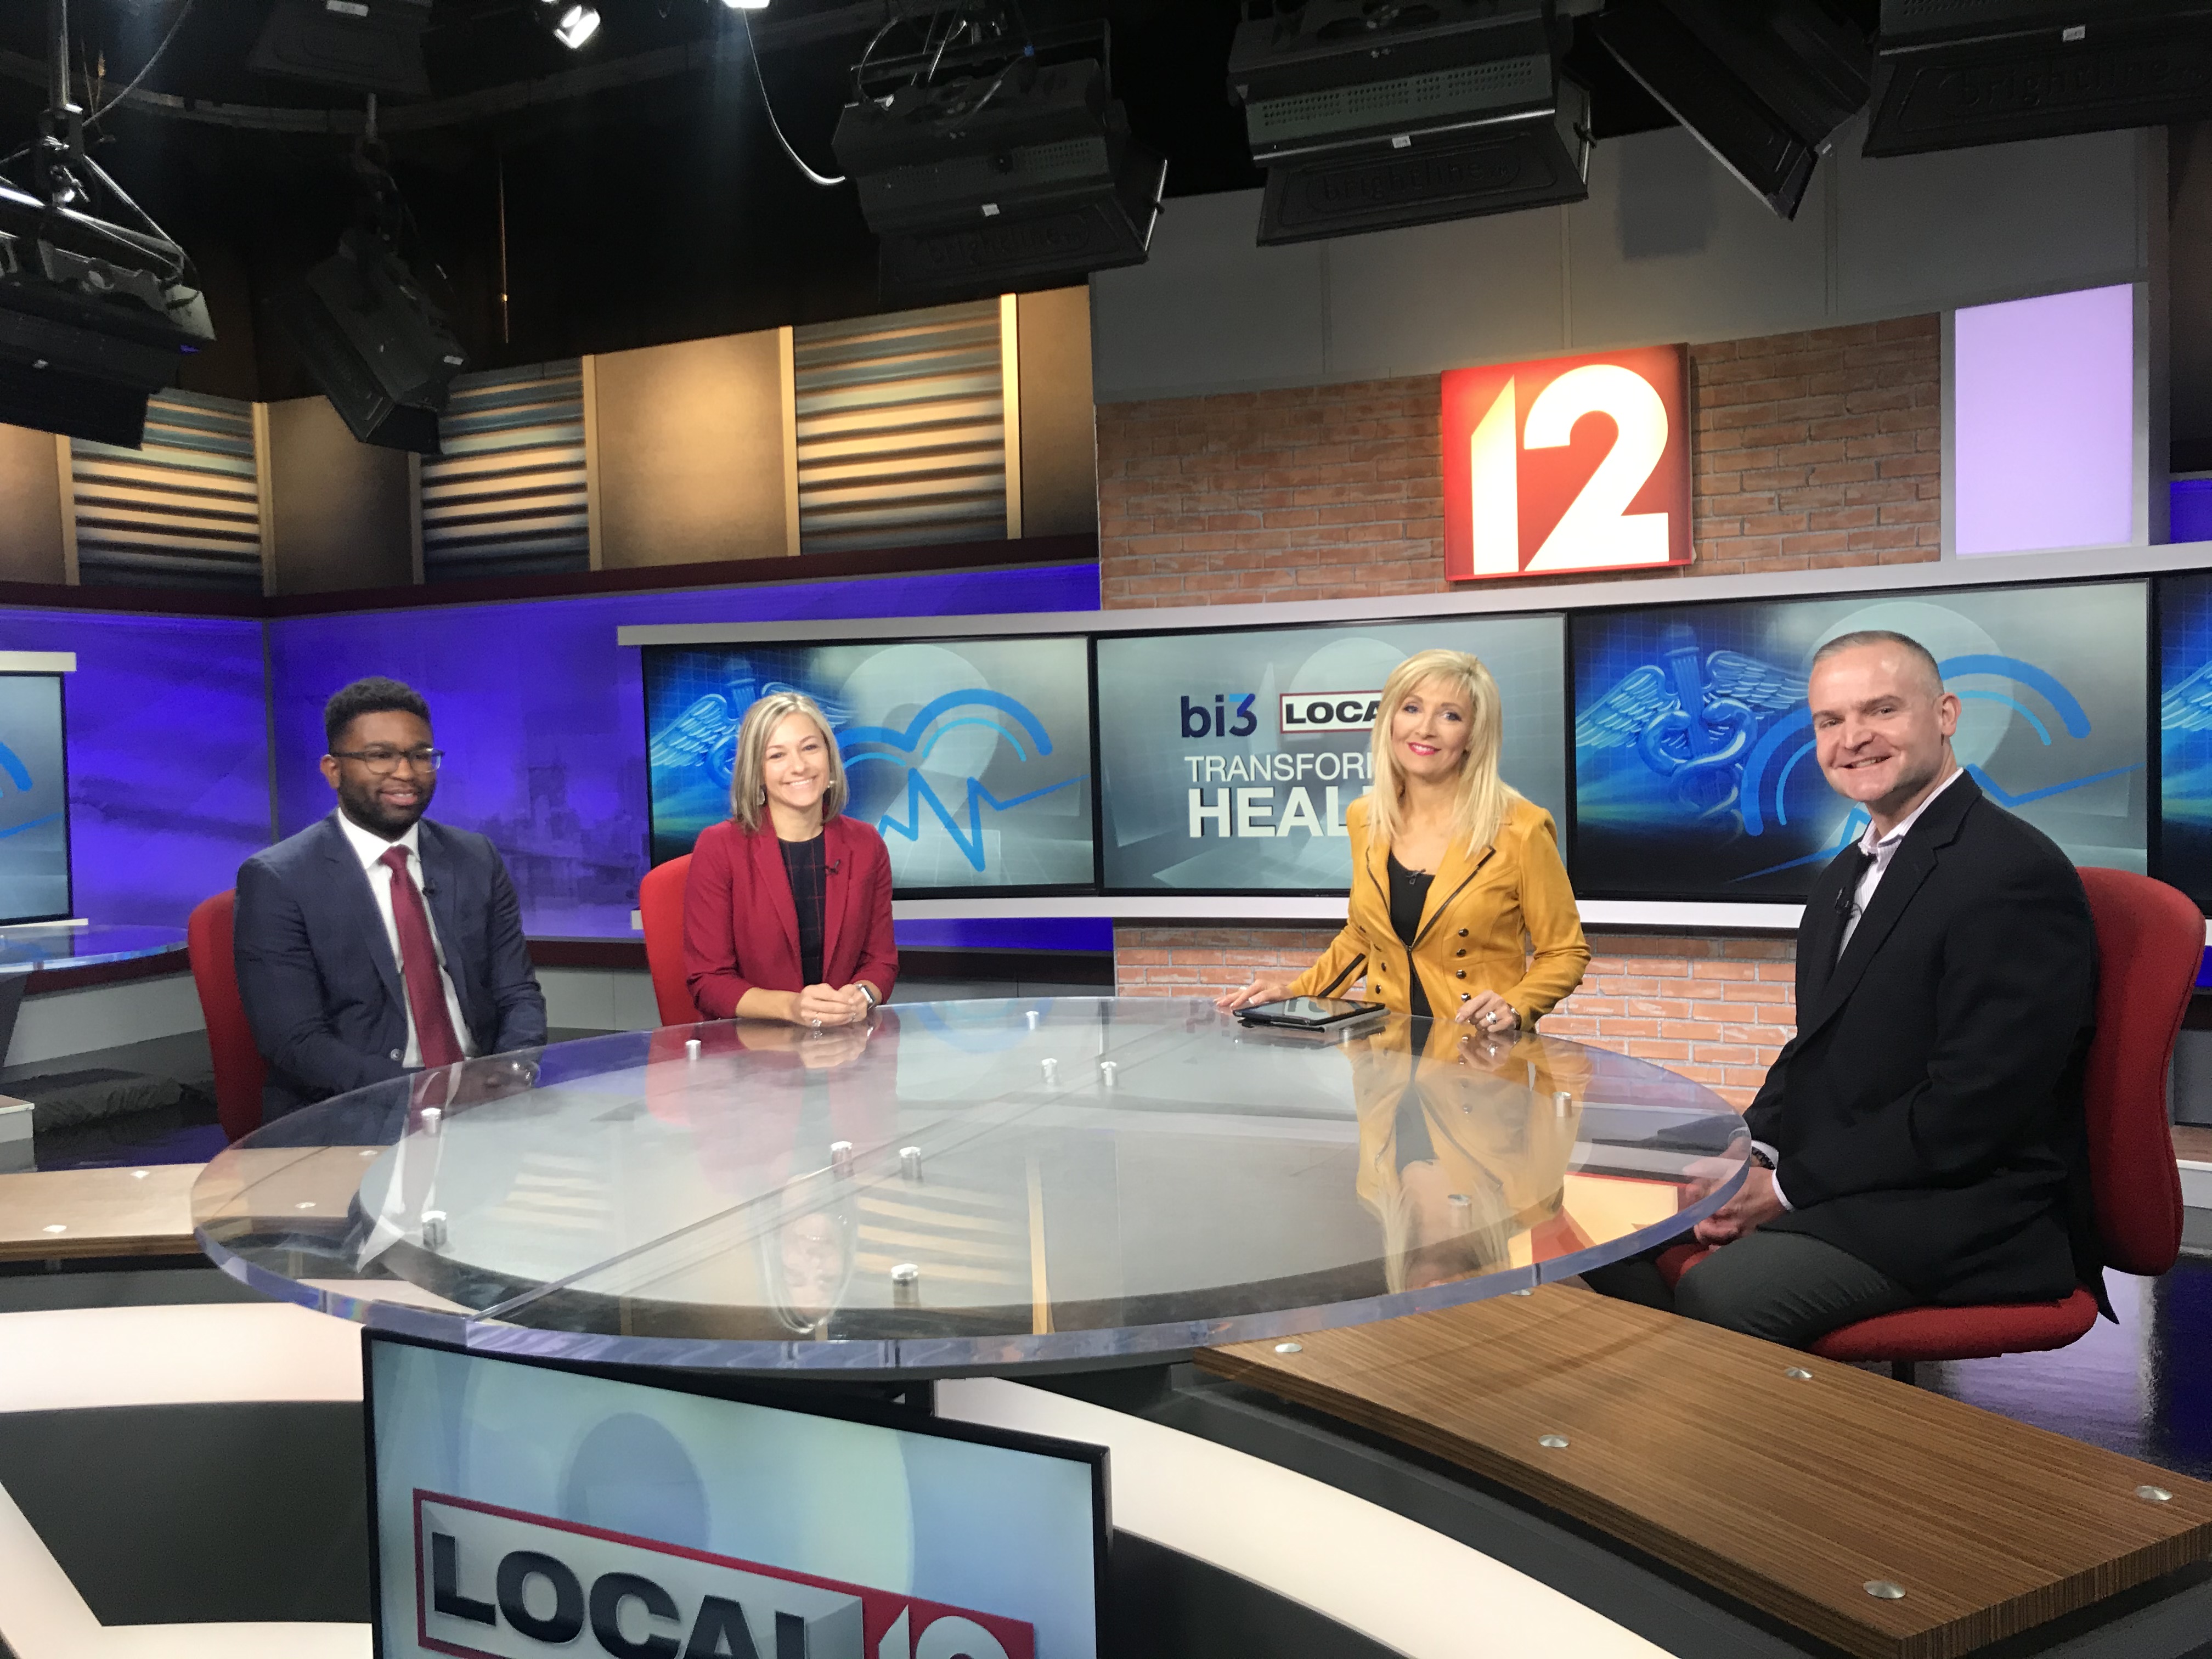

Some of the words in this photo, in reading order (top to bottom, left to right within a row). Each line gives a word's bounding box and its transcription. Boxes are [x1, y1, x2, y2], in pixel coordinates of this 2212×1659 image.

[1471, 364, 1669, 575] 12
[1181, 693, 1257, 738] bi3
[1184, 752, 1373, 782] TRANSFOR
[1188, 786, 1375, 838] HEAL
